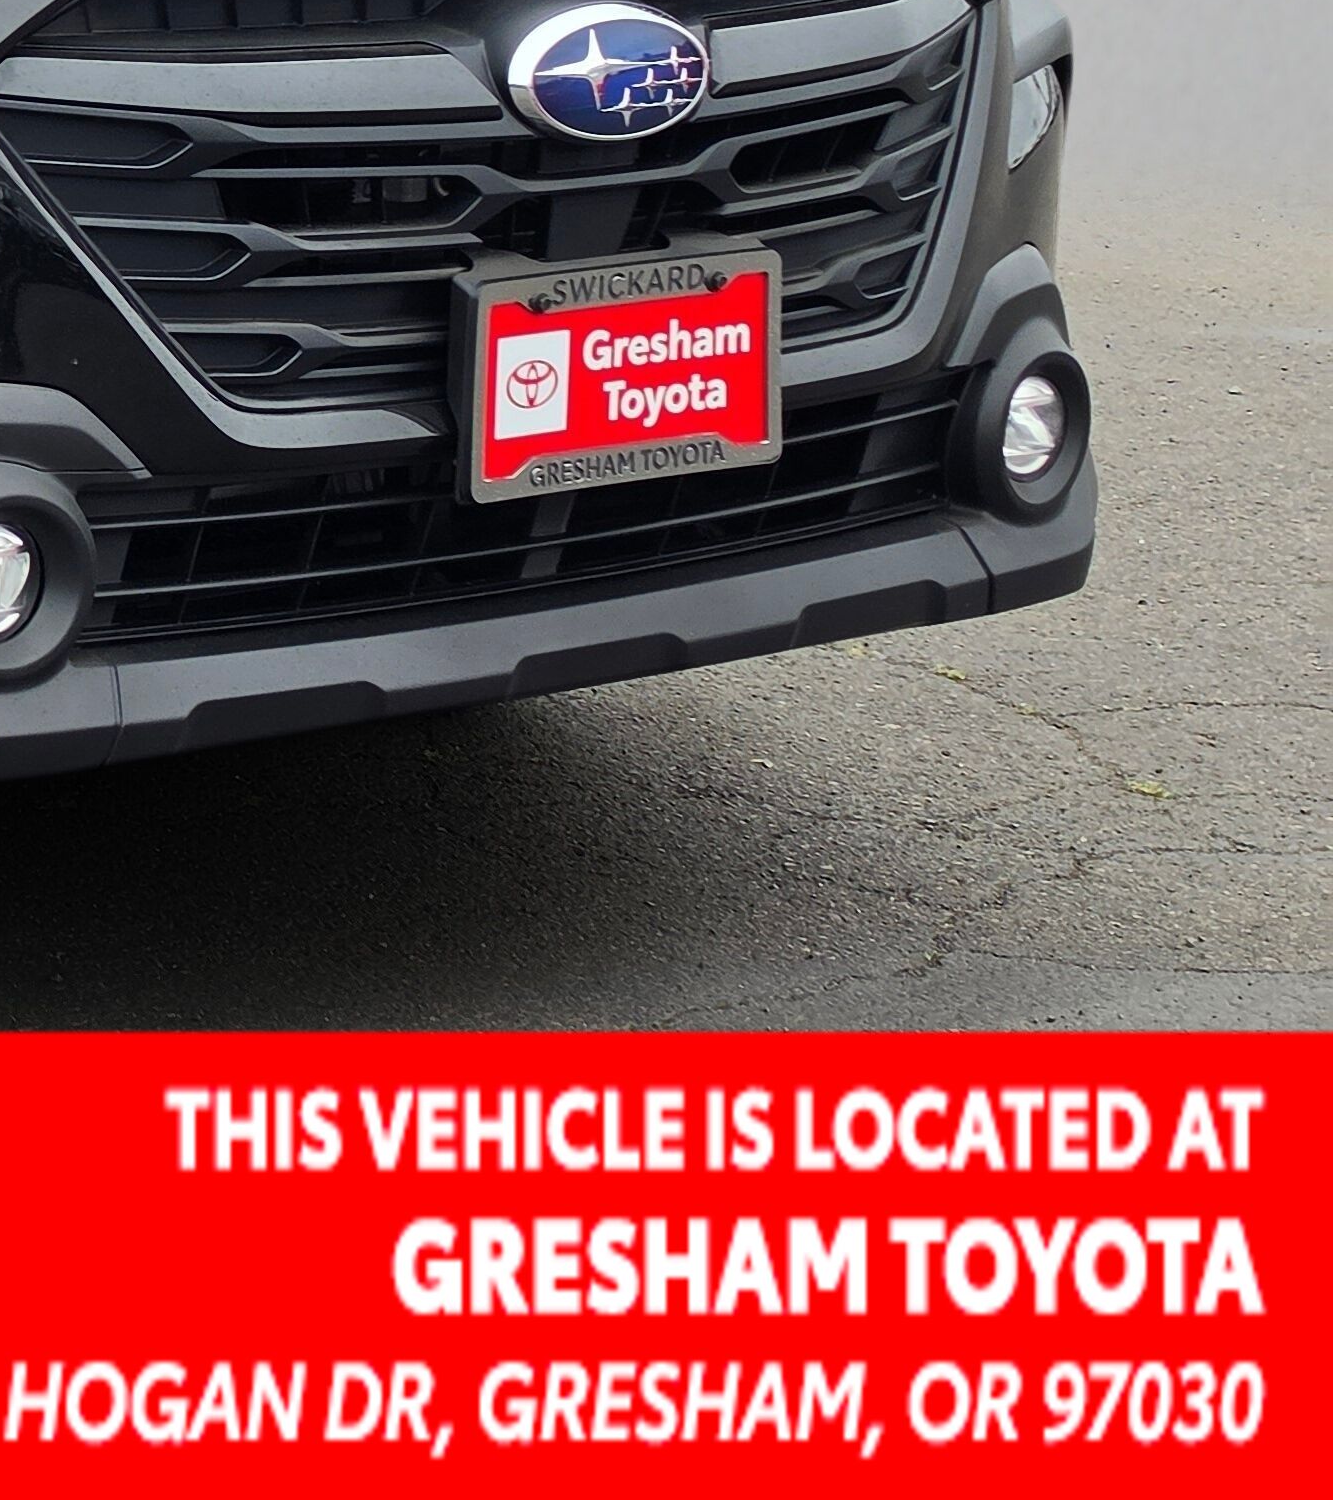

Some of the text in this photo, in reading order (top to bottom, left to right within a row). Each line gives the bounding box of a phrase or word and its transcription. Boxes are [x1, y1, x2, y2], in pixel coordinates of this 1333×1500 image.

[551, 262, 706, 306] SWICKARD
[582, 318, 751, 371] Gresham
[602, 373, 728, 428] Toyota
[528, 439, 726, 488] GRESHAM TOYOTA
